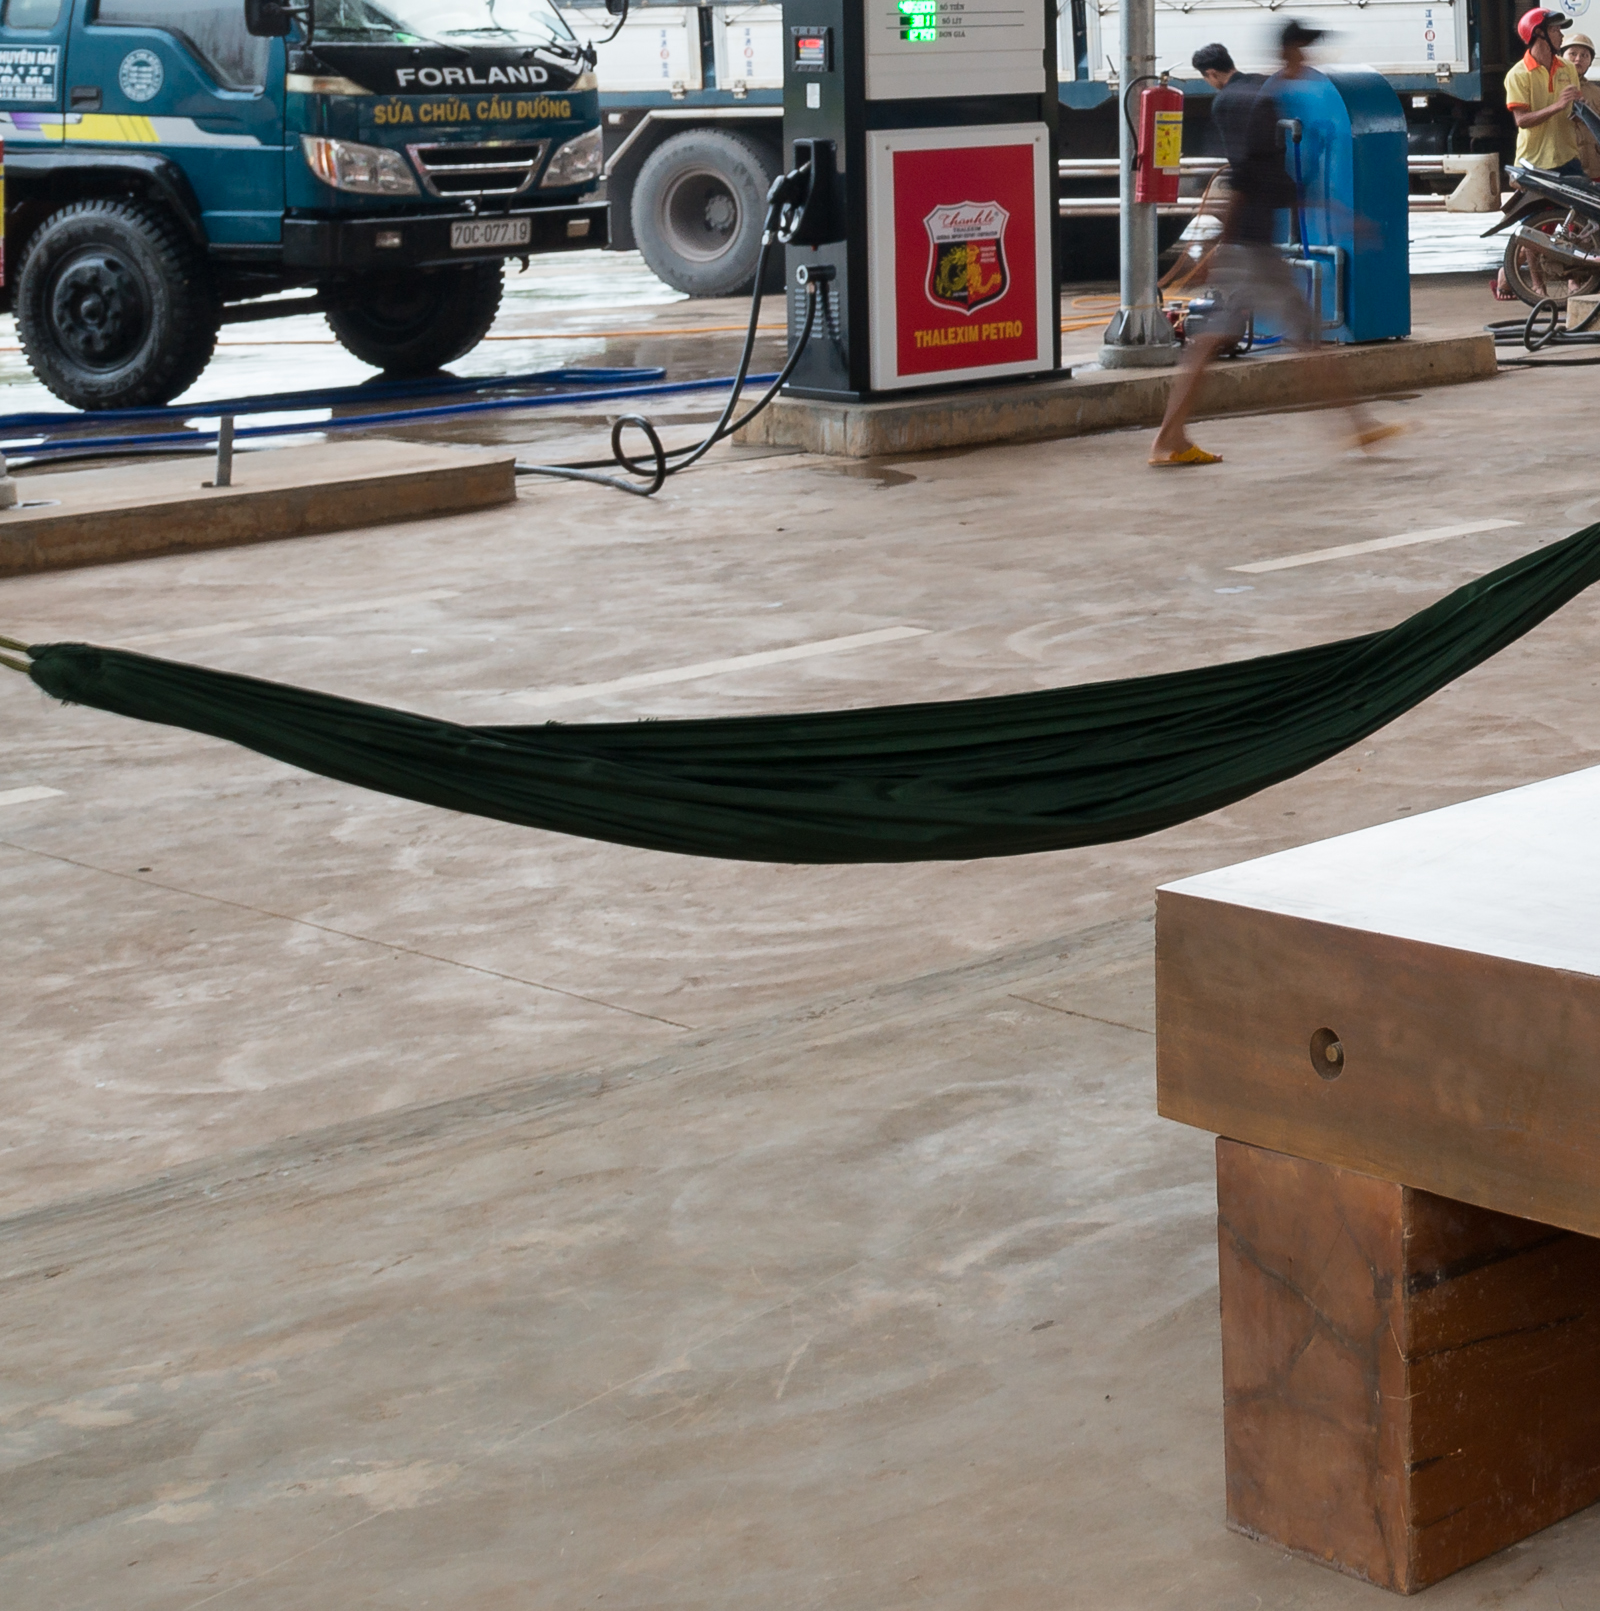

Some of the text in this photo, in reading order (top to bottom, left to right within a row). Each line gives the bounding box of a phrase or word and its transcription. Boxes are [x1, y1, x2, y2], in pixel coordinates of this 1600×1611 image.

[396, 66, 549, 87] FORLAND
[374, 96, 414, 124] SỬA
[418, 96, 471, 123] CHỮA
[516, 95, 572, 119] ĐƯỜNG
[455, 222, 528, 245] 70C-077.19
[914, 320, 1022, 348] THALEXIM PETRO
